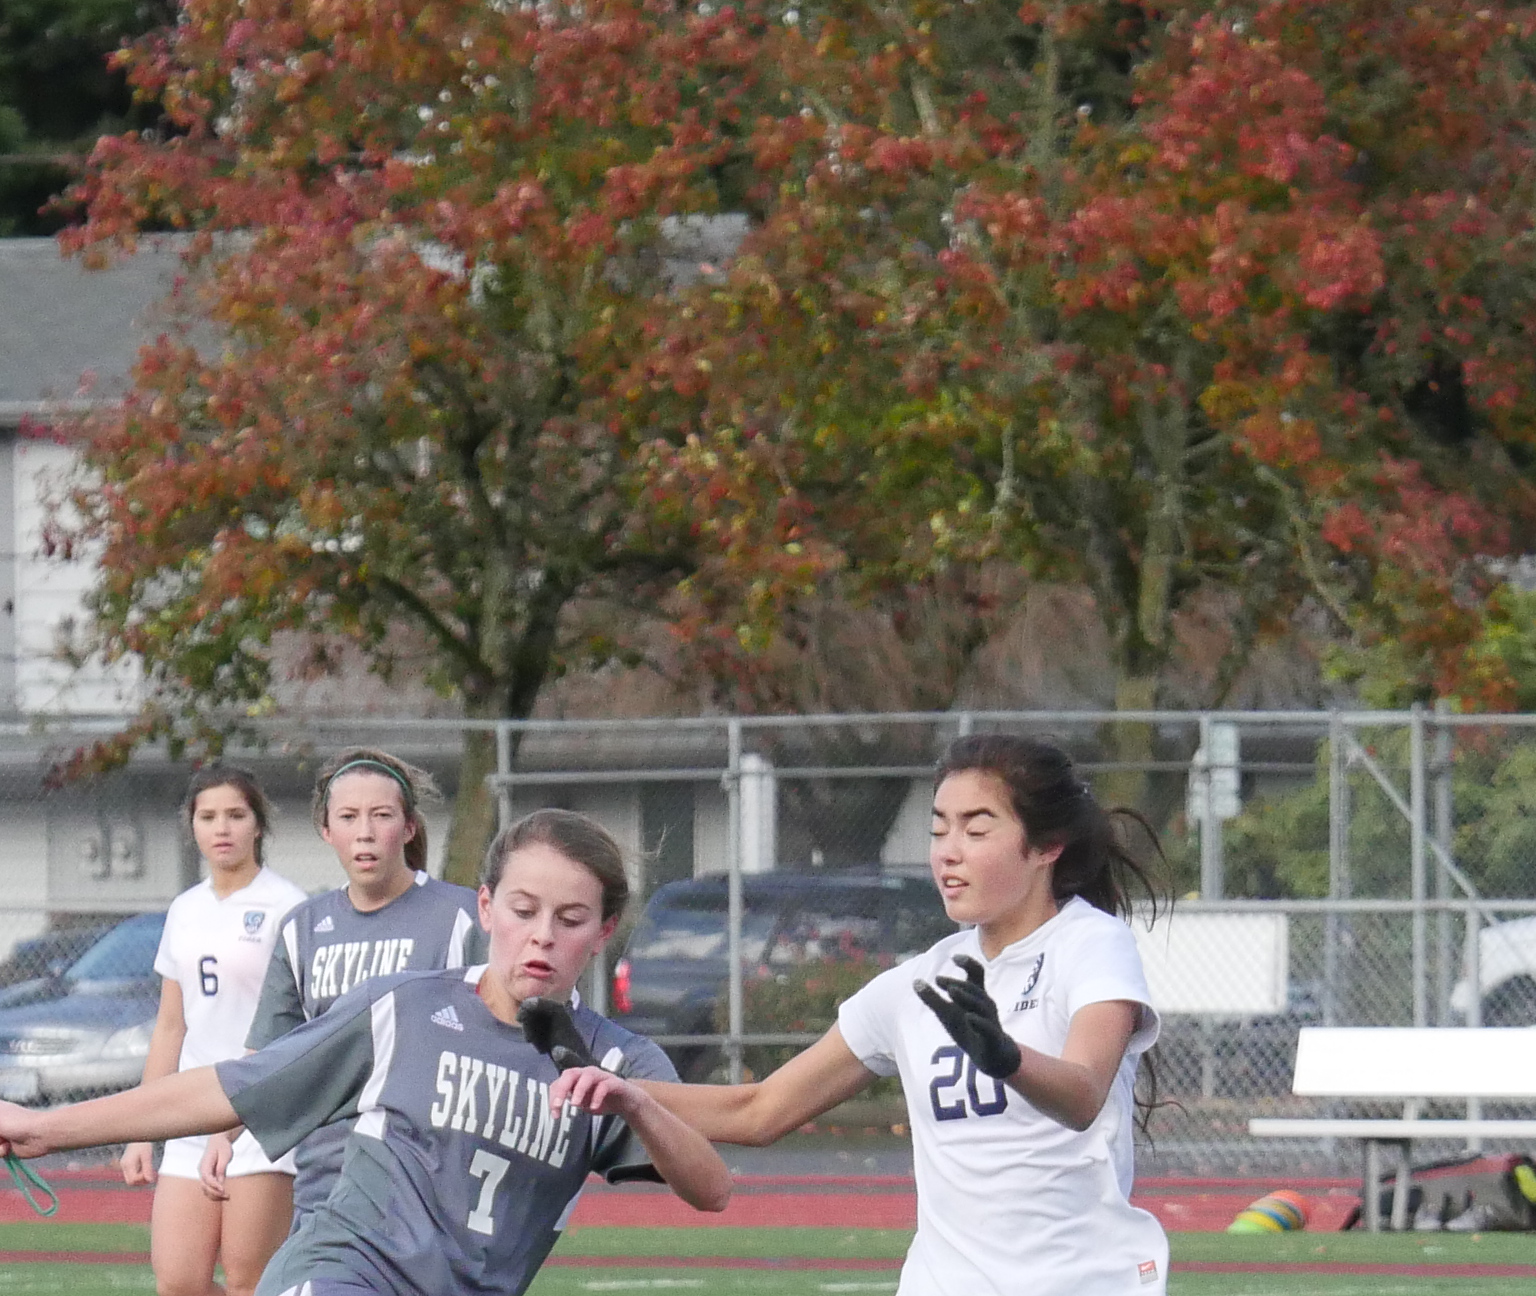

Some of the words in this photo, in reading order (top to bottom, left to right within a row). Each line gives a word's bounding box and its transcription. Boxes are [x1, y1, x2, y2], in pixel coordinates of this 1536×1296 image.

[197, 955, 219, 996] 6
[430, 1050, 578, 1169] SKYLINE
[929, 1045, 1008, 1121] 20
[467, 1149, 512, 1235] 7
